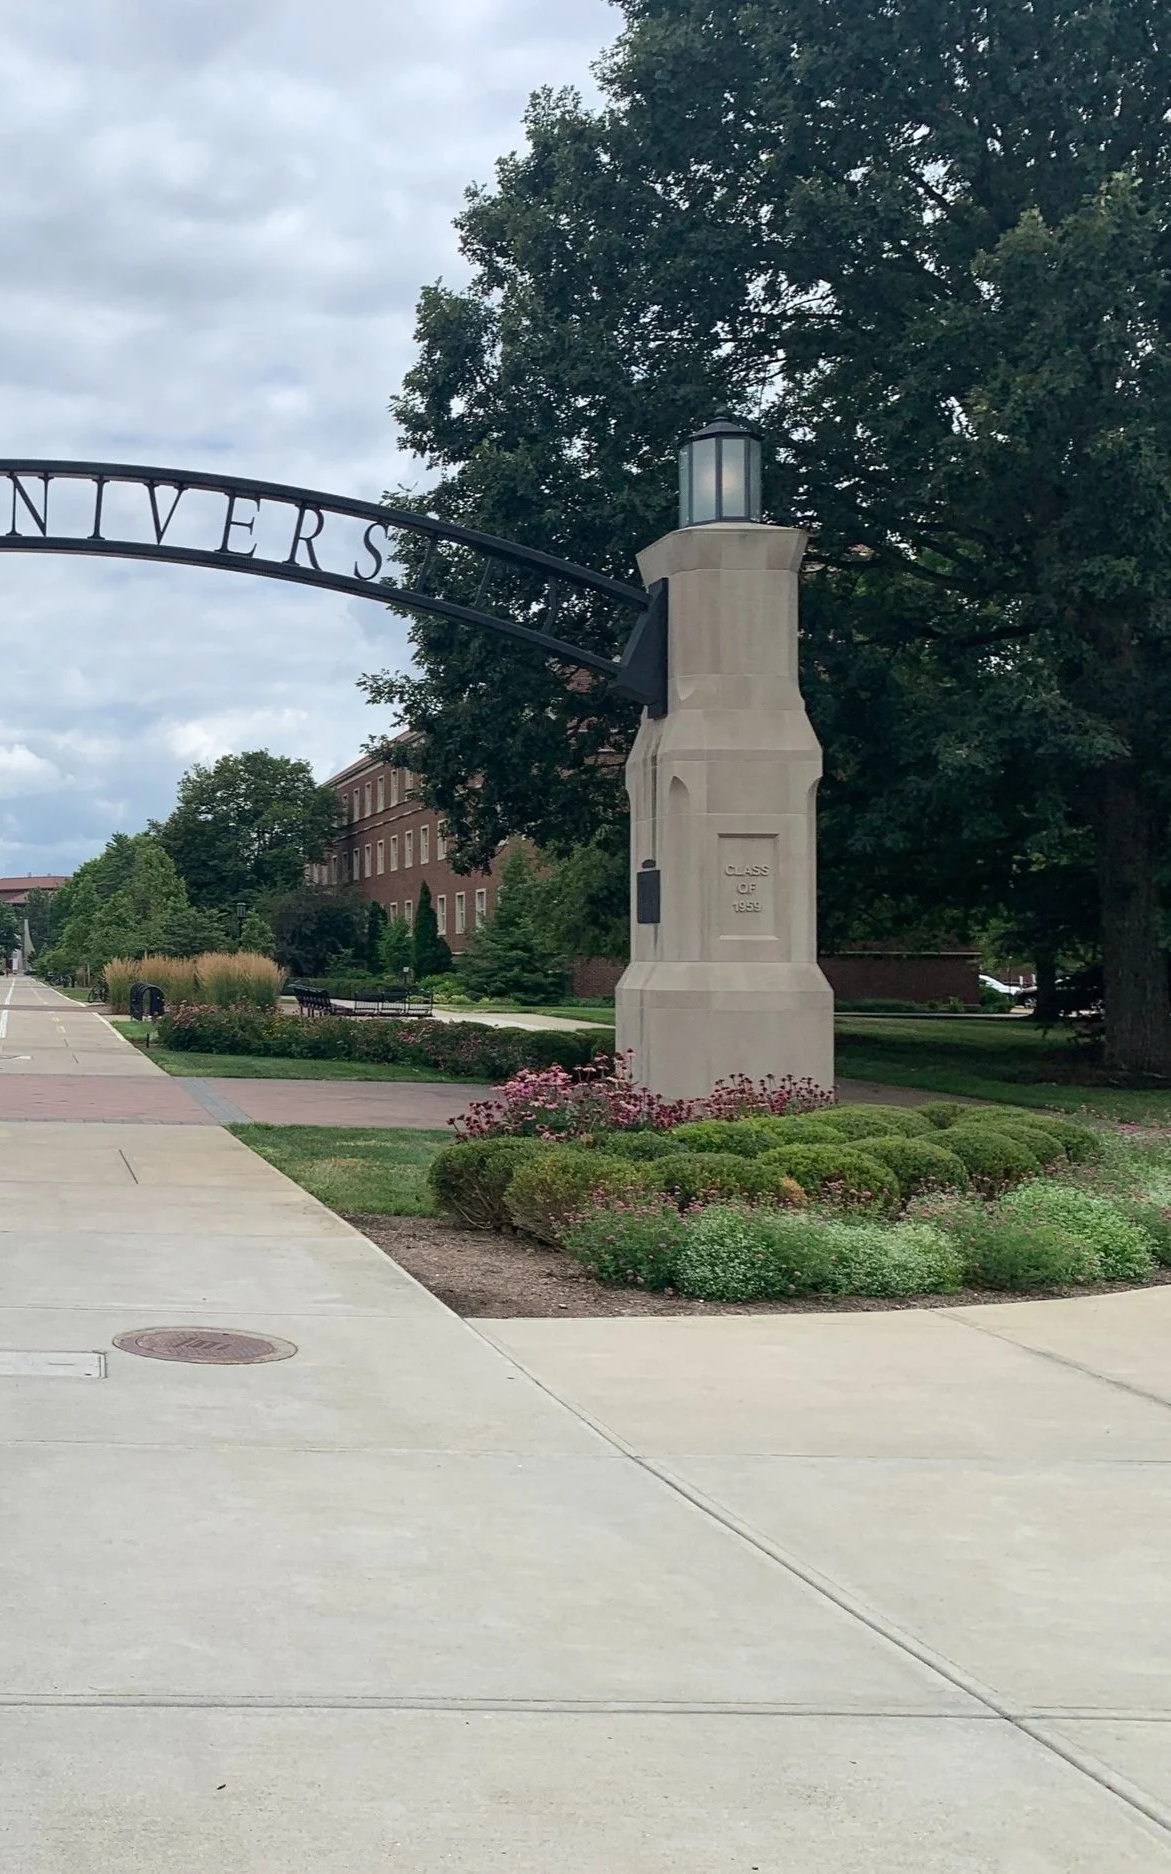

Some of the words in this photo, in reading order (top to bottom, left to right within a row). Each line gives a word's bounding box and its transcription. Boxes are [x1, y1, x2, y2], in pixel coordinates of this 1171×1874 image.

[725, 864, 770, 877] CLASS
[737, 882, 757, 895] OF
[732, 900, 762, 913] 1959
